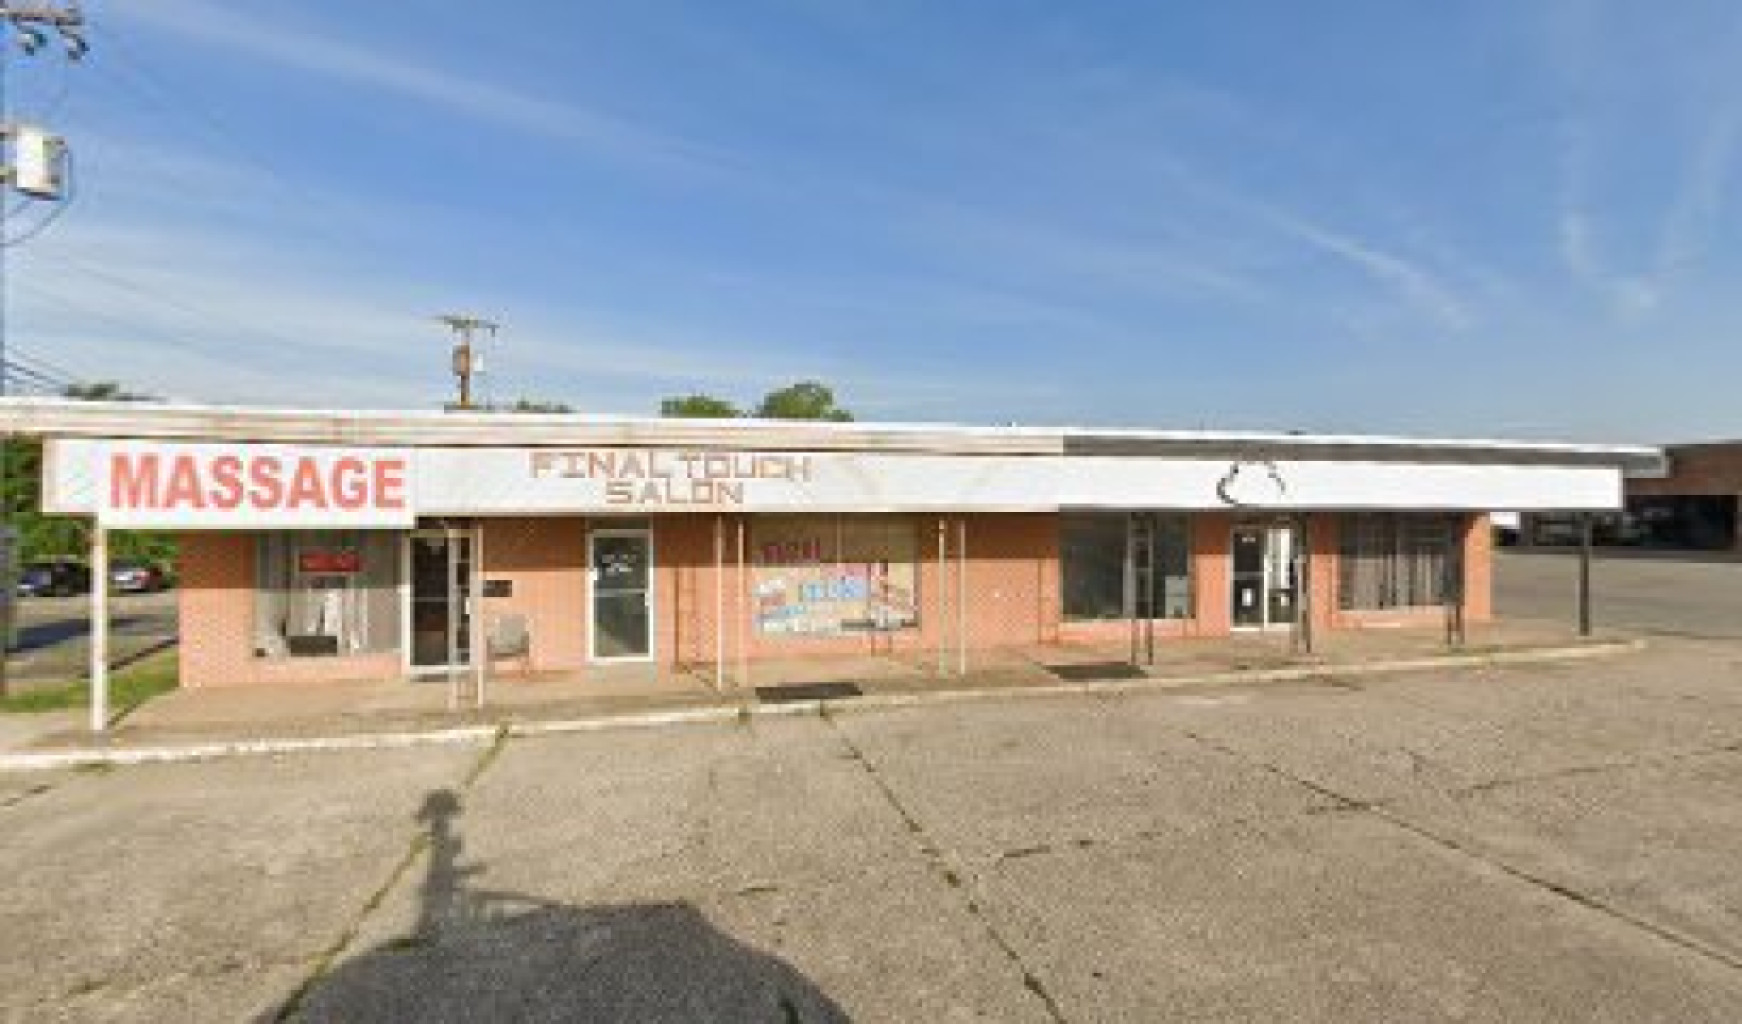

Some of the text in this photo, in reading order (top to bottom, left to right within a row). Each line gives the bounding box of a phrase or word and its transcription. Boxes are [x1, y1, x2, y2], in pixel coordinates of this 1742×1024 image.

[110, 452, 405, 509] MASSAGE
[530, 451, 812, 481] FINAL TOUCH
[605, 481, 744, 504] SALON
